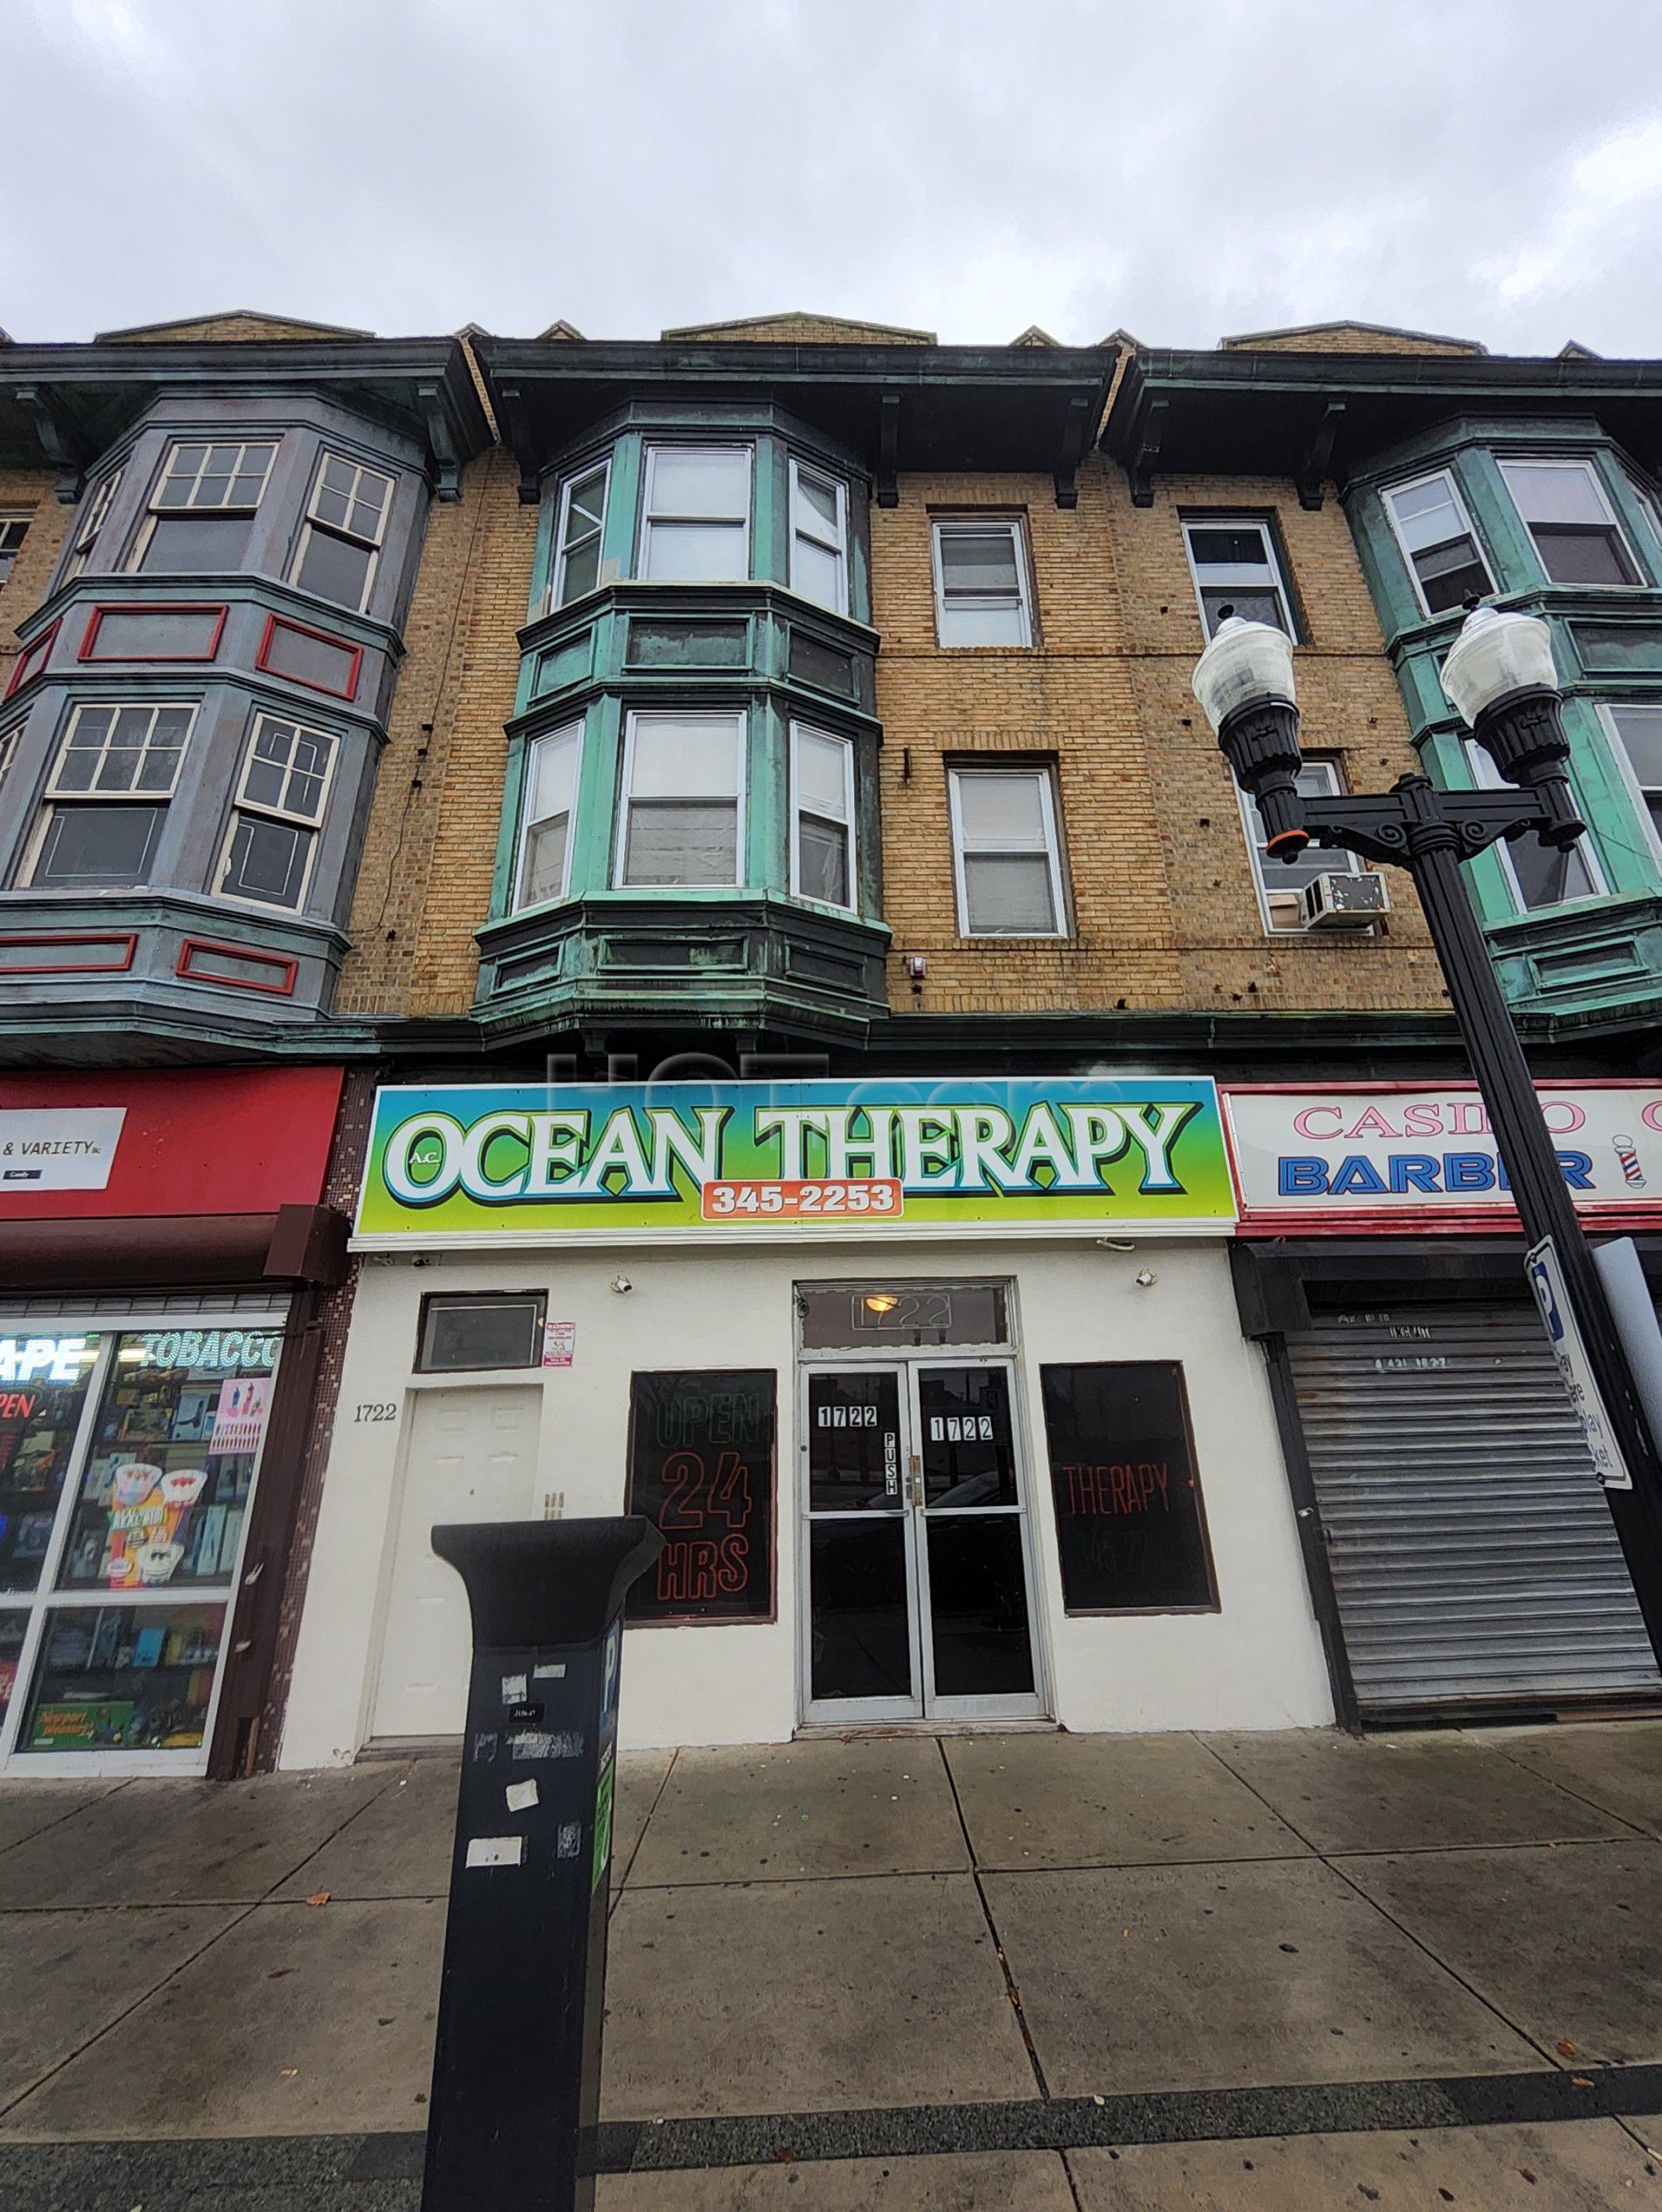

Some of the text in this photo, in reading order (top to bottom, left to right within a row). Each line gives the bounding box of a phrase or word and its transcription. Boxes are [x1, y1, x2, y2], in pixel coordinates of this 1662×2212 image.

[3, 1141, 15, 1155] &
[22, 1141, 94, 1155] VARIETY
[383, 1101, 1205, 1210] OCEAN THERAPY
[711, 1184, 895, 1214] 345-2253
[353, 1403, 398, 1423] 1722
[655, 1392, 761, 1449] OPEN
[819, 1407, 877, 1427] 1722
[932, 1417, 993, 1440] 1722
[659, 1451, 753, 1530] 24
[885, 1433, 897, 1495] PUSH
[1062, 1462, 1170, 1516] THERAPY
[657, 1533, 750, 1601] HRS
